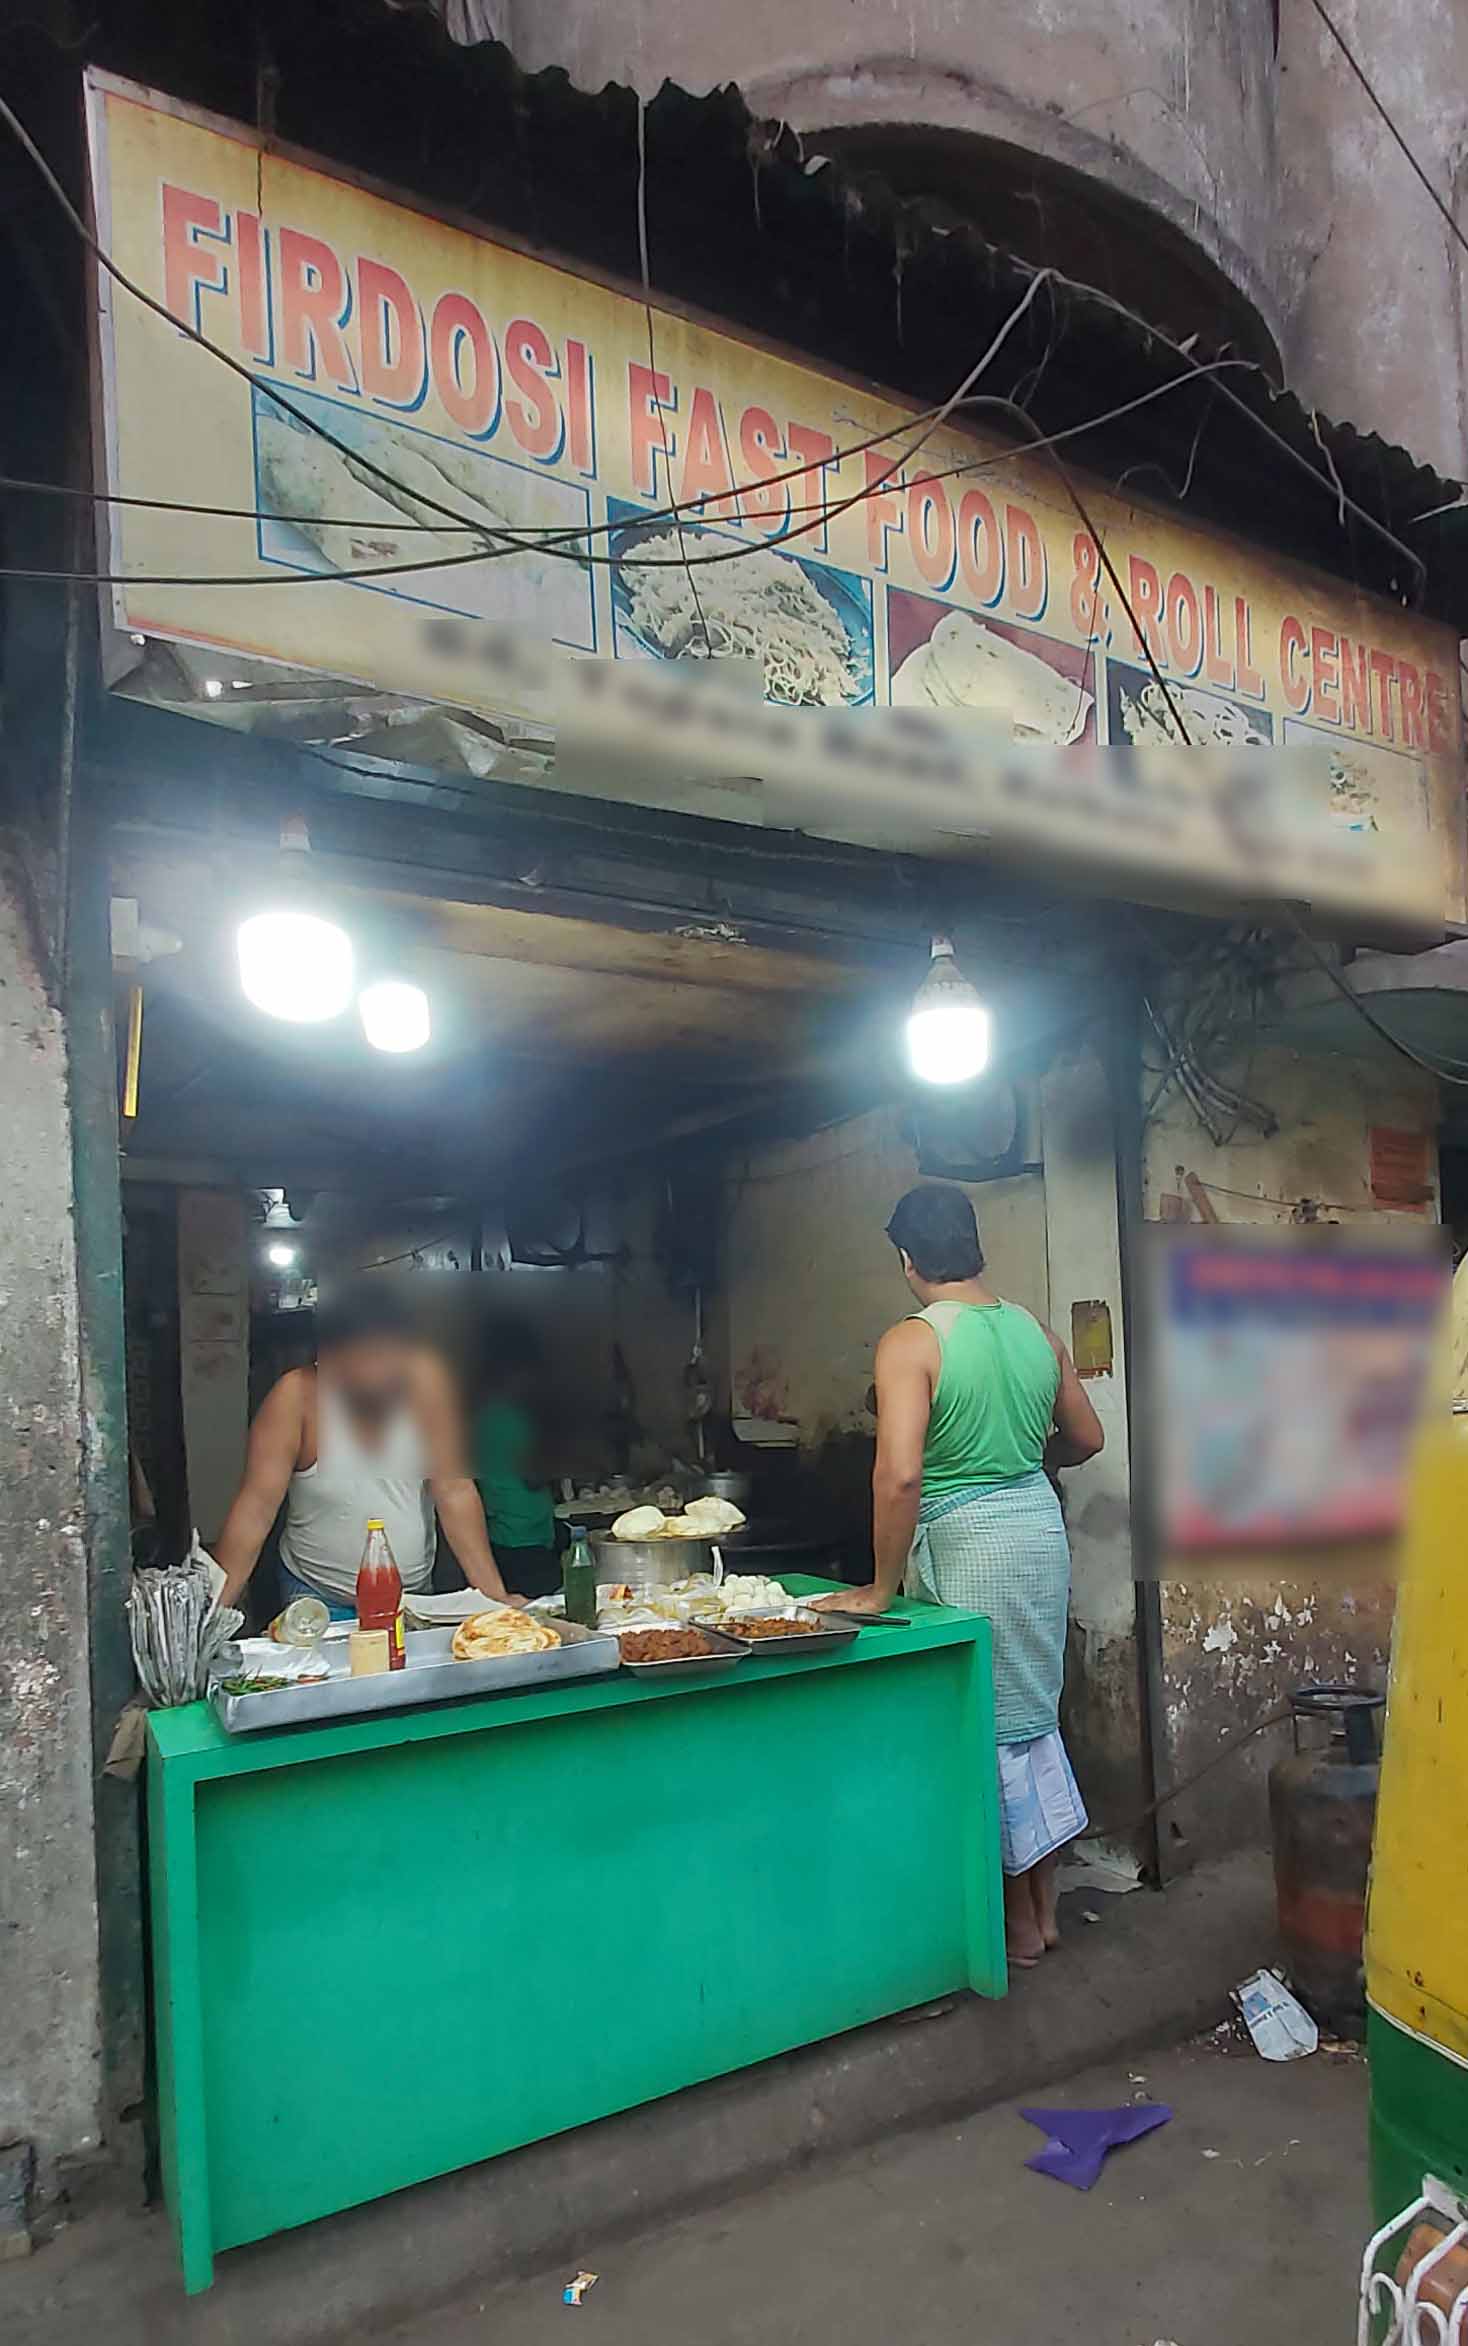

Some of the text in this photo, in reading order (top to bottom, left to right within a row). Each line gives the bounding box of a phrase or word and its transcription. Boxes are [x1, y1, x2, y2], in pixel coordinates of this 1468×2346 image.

[162, 181, 598, 481] FIRDOSI
[627, 361, 841, 554] FAST
[864, 449, 1048, 623] FOOD
[1070, 530, 1112, 648] &
[1129, 553, 1265, 700] ROLL
[1279, 615, 1451, 755] CENTRE
